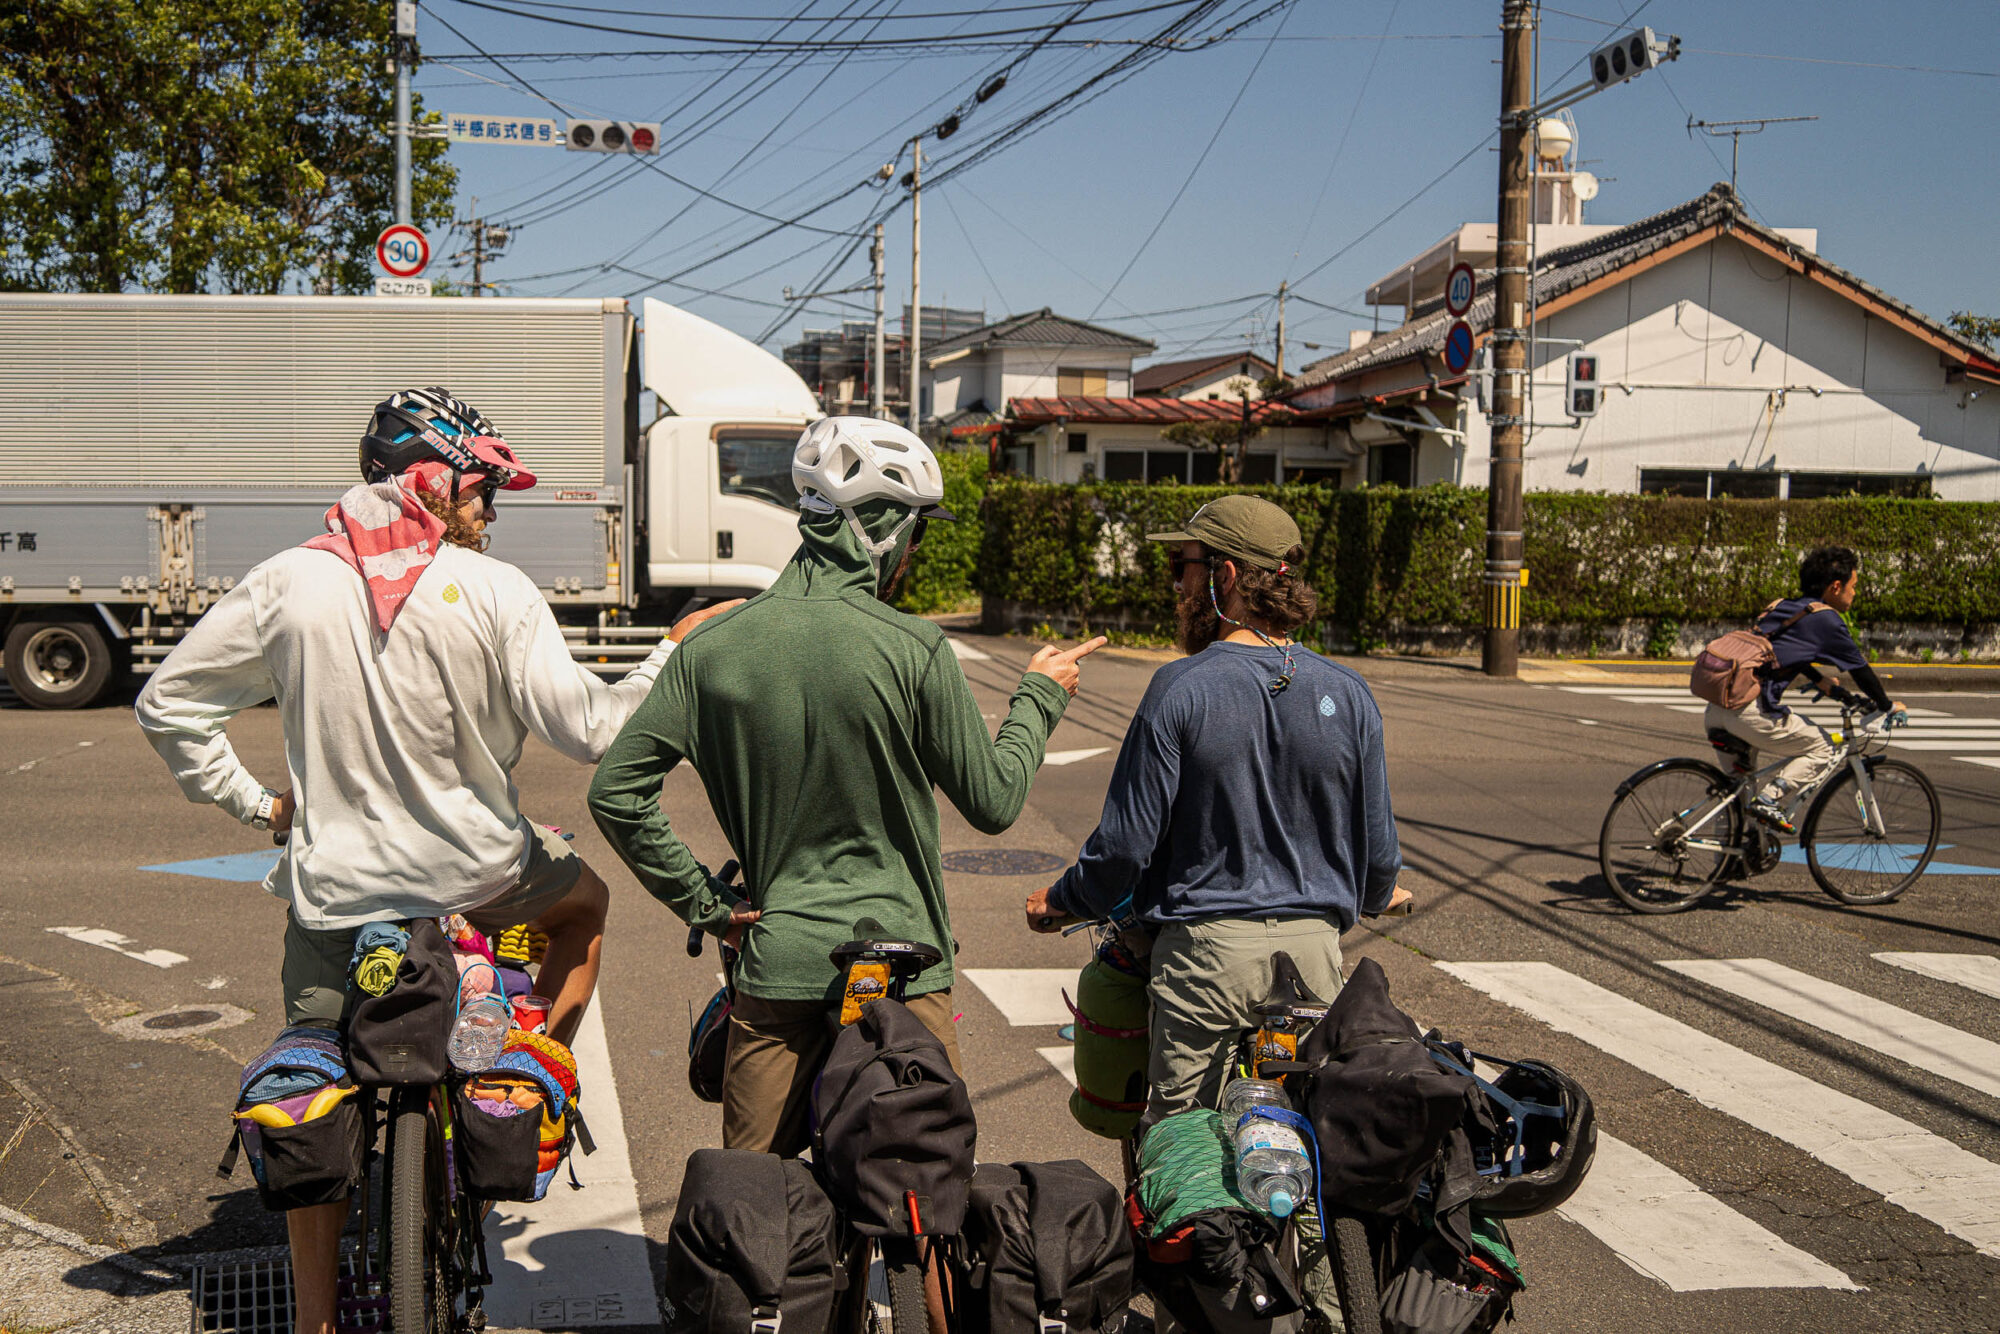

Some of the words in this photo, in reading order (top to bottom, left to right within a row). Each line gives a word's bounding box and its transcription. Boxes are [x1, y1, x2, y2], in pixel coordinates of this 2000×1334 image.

[452, 118, 551, 141] 半感応式信号
[389, 240, 418, 263] 30
[381, 282, 427, 295] ここから
[1452, 277, 1469, 303] 40
[419, 428, 473, 470] SMITH
